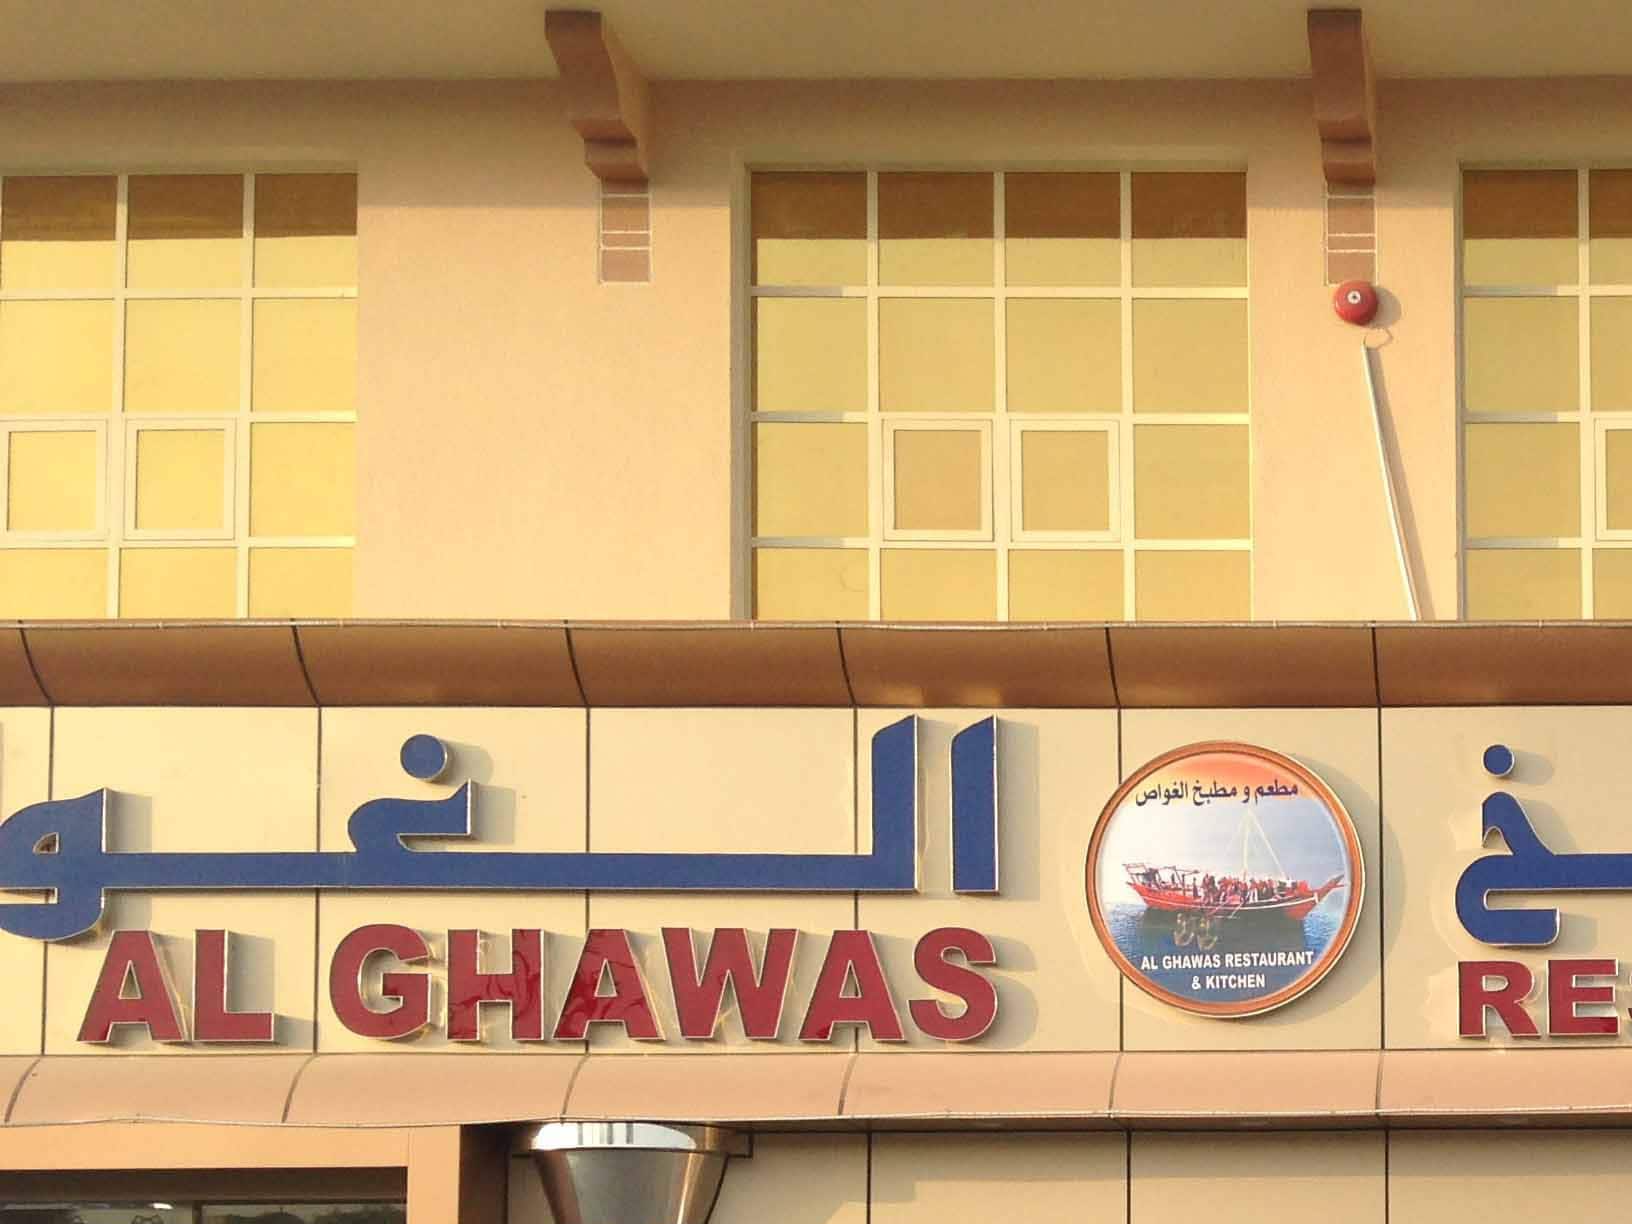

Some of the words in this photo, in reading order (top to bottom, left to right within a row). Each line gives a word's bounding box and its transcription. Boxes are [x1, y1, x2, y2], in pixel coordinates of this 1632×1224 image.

[1134, 780, 1188, 807] الغواص
[1140, 956, 1158, 970] AL
[1162, 953, 1221, 970] GHAWAS
[1225, 951, 1314, 967] RESTAURANT
[77, 929, 276, 1044] AL
[328, 923, 999, 1042] GHAWAS
[1191, 976, 1201, 990] &
[1206, 973, 1266, 989] KITCHEN
